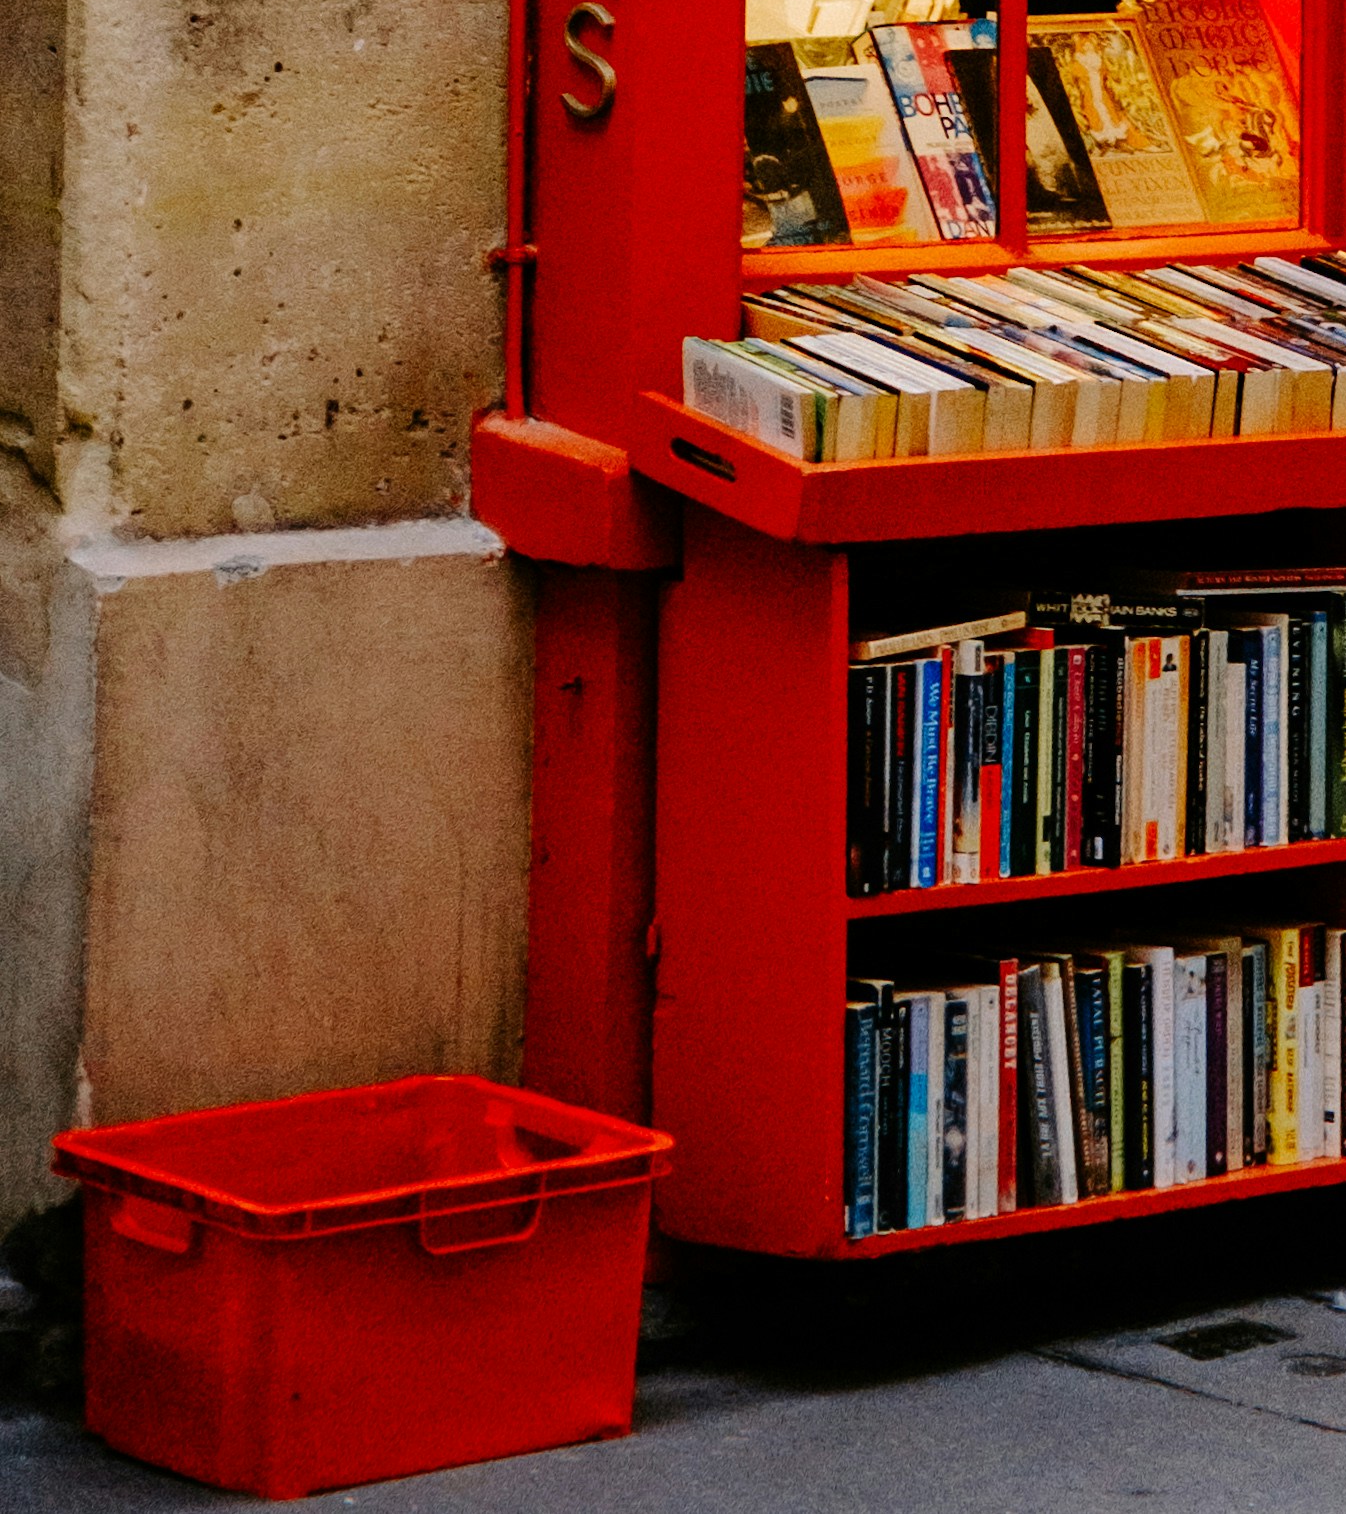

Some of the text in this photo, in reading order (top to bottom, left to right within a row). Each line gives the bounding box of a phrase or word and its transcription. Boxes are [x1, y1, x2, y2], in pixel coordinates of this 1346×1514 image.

[1135, 605, 1177, 617] BANKS
[928, 682, 939, 707] We
[1248, 658, 1259, 738] My Secret Life
[1290, 626, 1301, 717] EVENING
[924, 710, 938, 750] Must
[984, 704, 998, 763] DIBDIN
[924, 778, 936, 824] Brave
[880, 1026, 893, 1087] MOOCH
[1091, 976, 1106, 1107] FATAL PURSUIT
[857, 1017, 875, 1188] Bernard Cornwell
